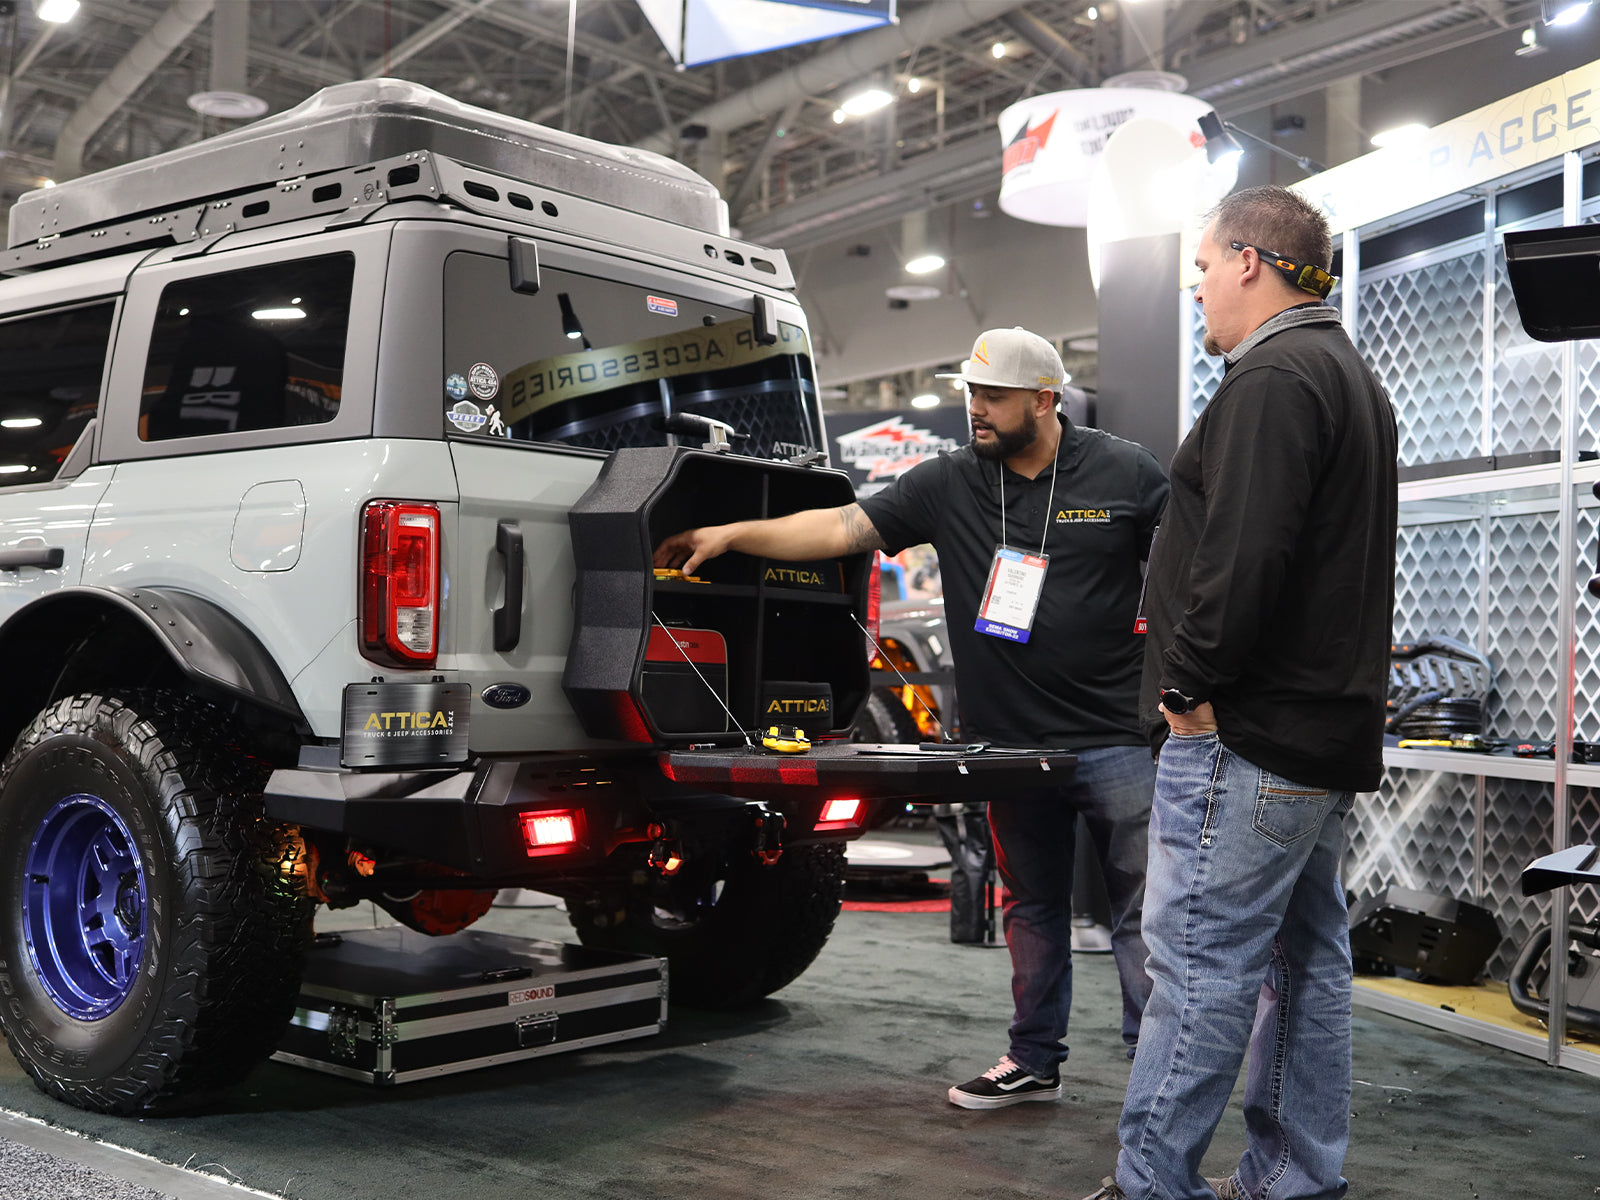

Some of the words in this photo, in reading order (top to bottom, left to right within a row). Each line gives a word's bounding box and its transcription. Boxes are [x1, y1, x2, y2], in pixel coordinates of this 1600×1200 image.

[1468, 88, 1593, 168] ACCE
[1056, 509, 1107, 519] ATTICA
[764, 567, 821, 585] ATTICA
[766, 698, 827, 713] ATTICA
[363, 710, 448, 730] ATTICA
